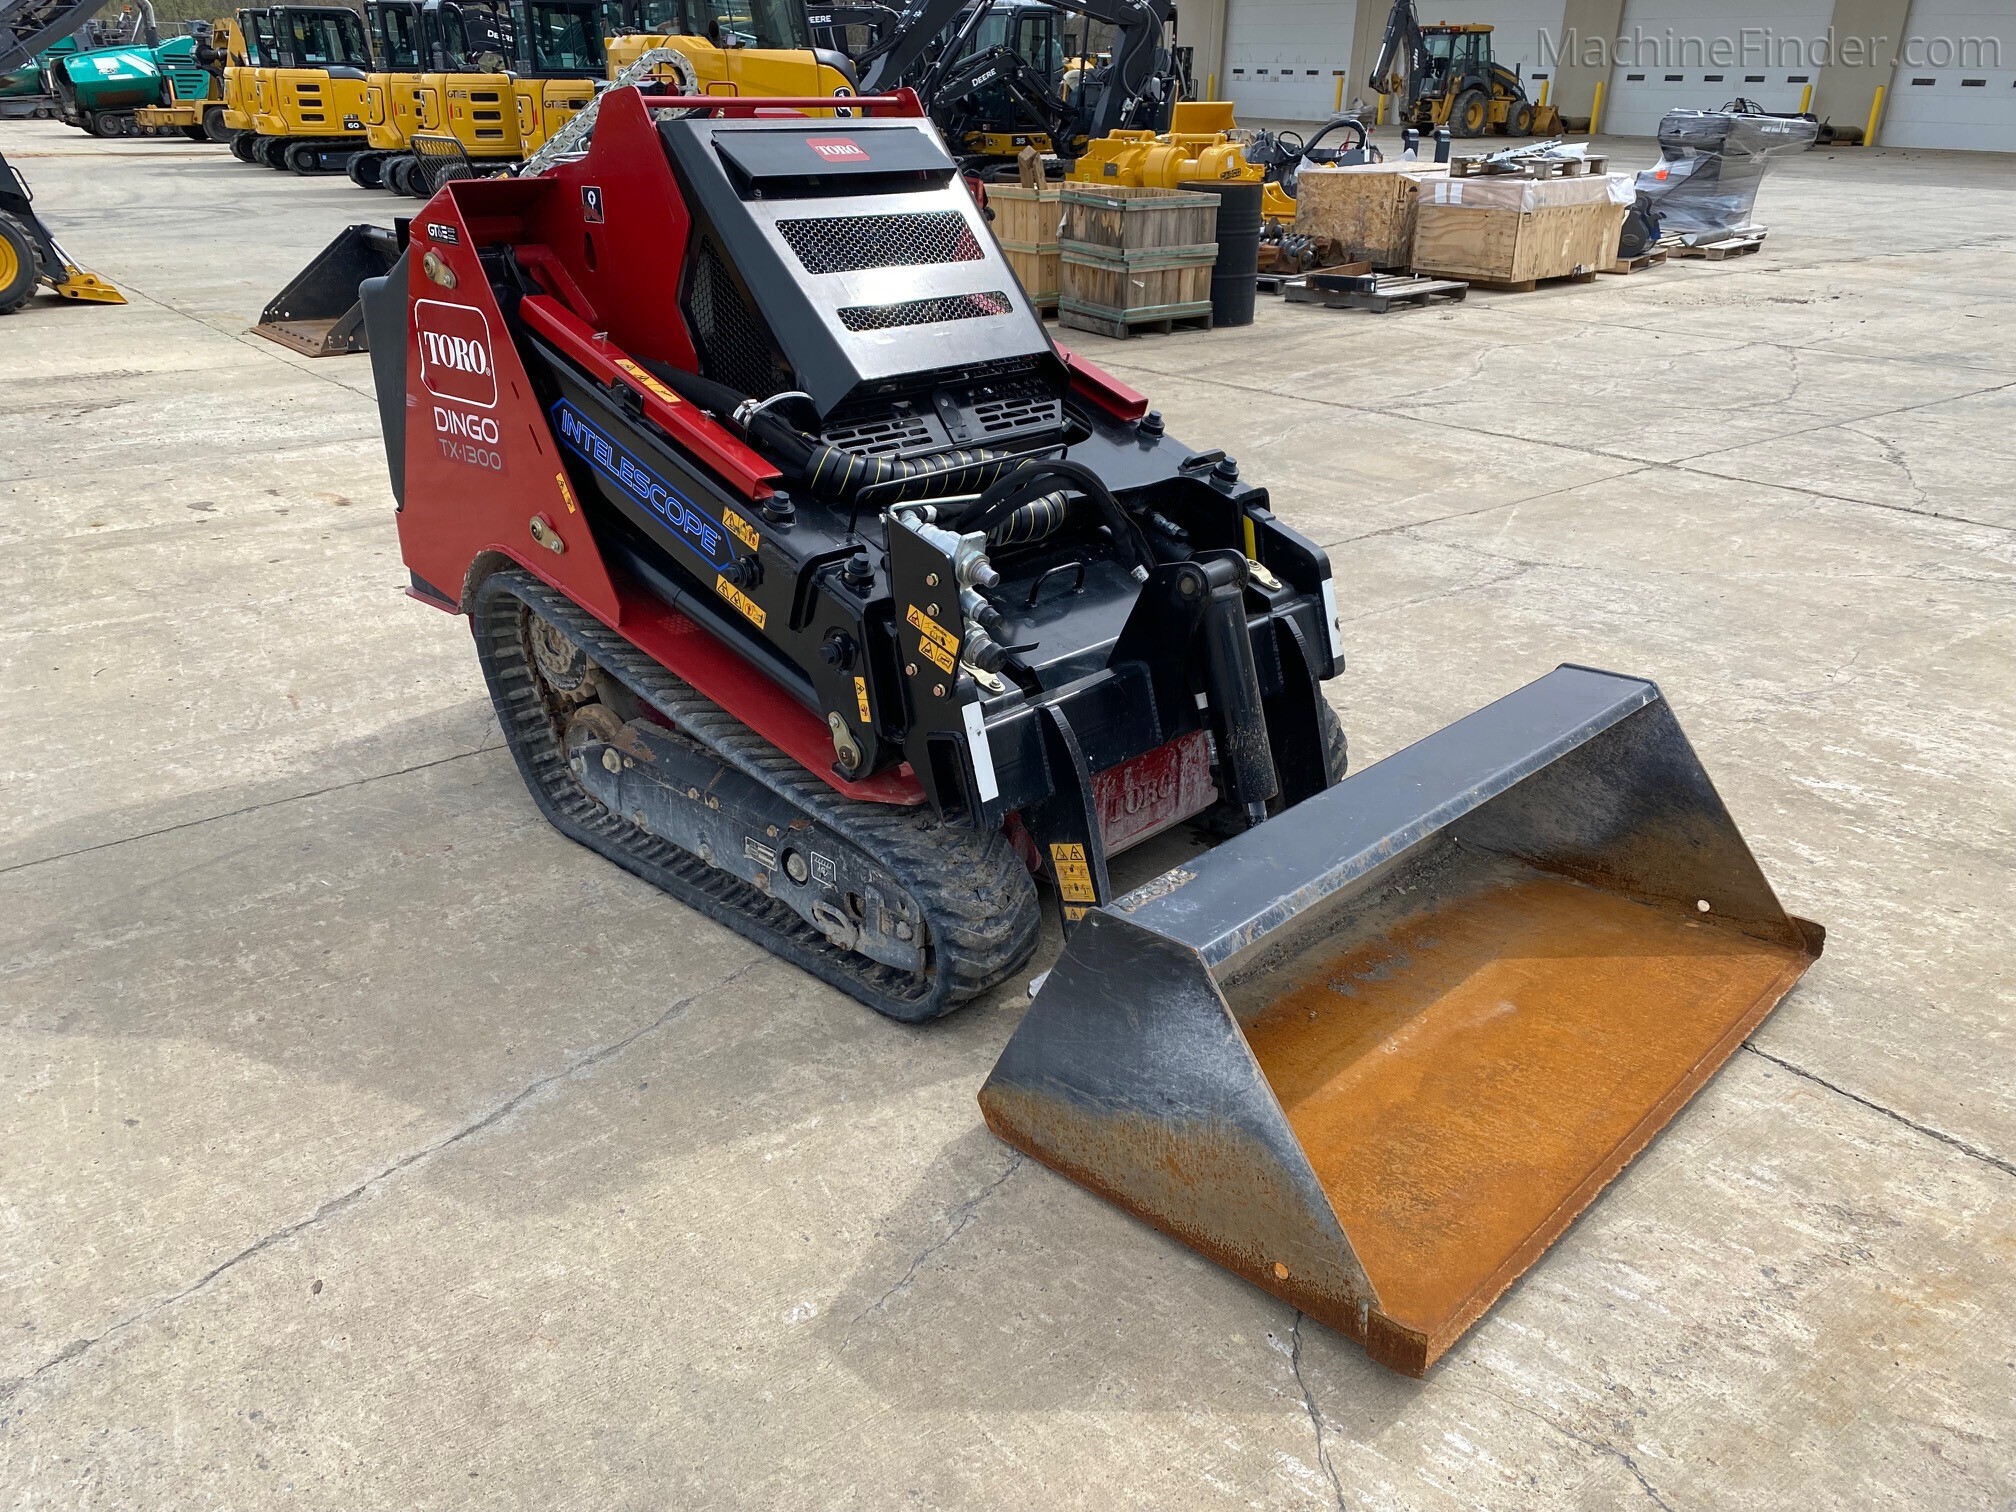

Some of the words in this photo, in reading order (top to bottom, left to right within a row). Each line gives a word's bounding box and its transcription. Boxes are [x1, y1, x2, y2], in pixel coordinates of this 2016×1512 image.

[808, 15, 832, 24] EERE
[971, 67, 997, 87] DEERE
[1015, 137, 1026, 145] 35
[561, 408, 718, 556] INTELESCOPE
